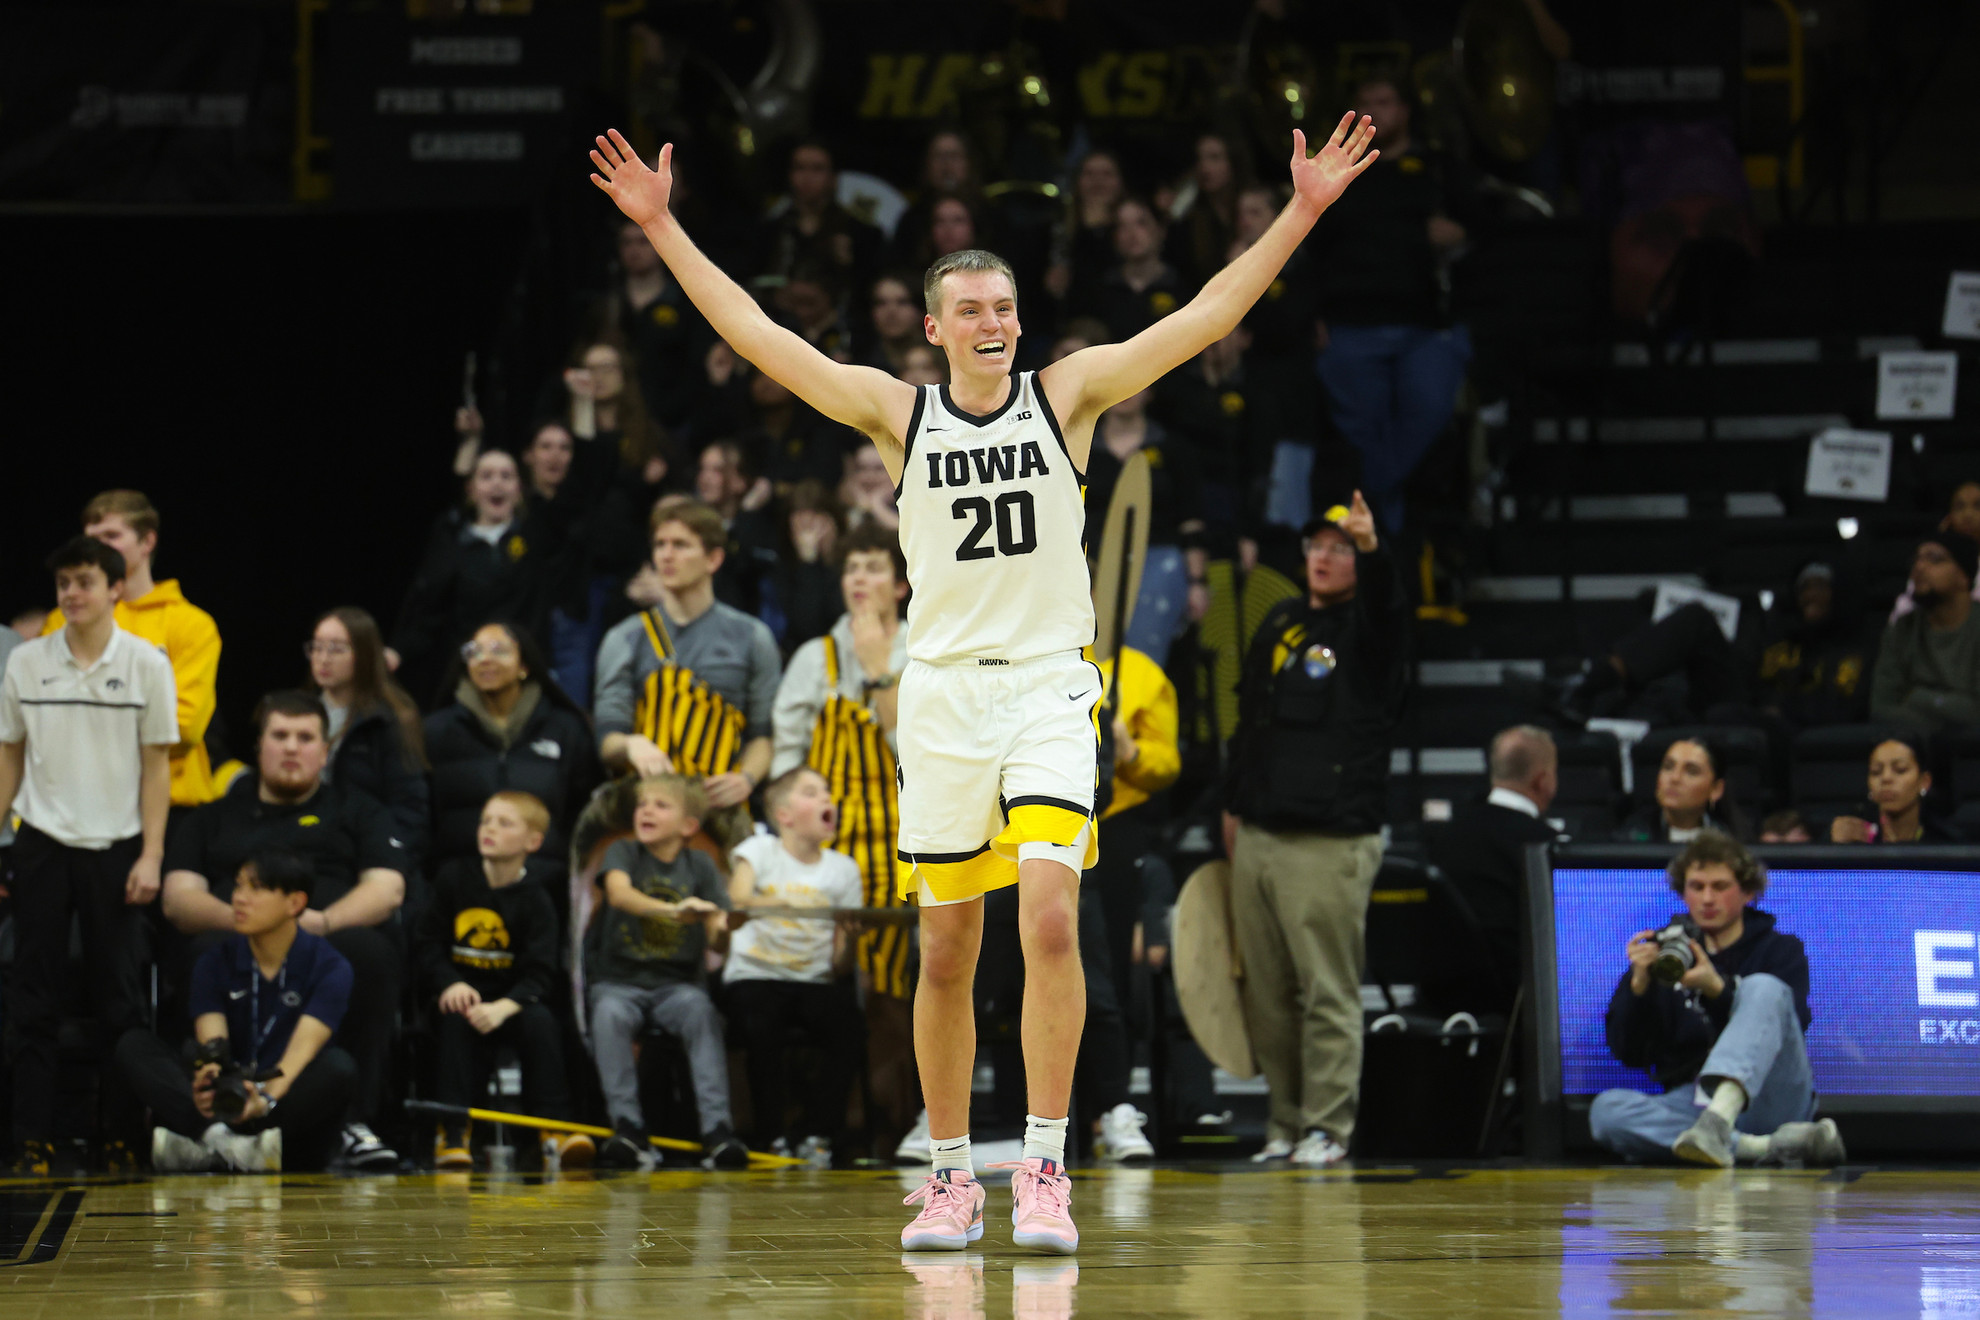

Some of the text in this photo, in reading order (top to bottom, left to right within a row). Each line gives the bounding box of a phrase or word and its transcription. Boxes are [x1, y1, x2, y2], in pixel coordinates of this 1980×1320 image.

[926, 441, 1049, 488] IOWA
[951, 490, 1037, 561] 20
[978, 658, 1010, 666] HAWKS
[1914, 930, 1980, 1007] E
[1919, 1019, 1980, 1045] EXC
